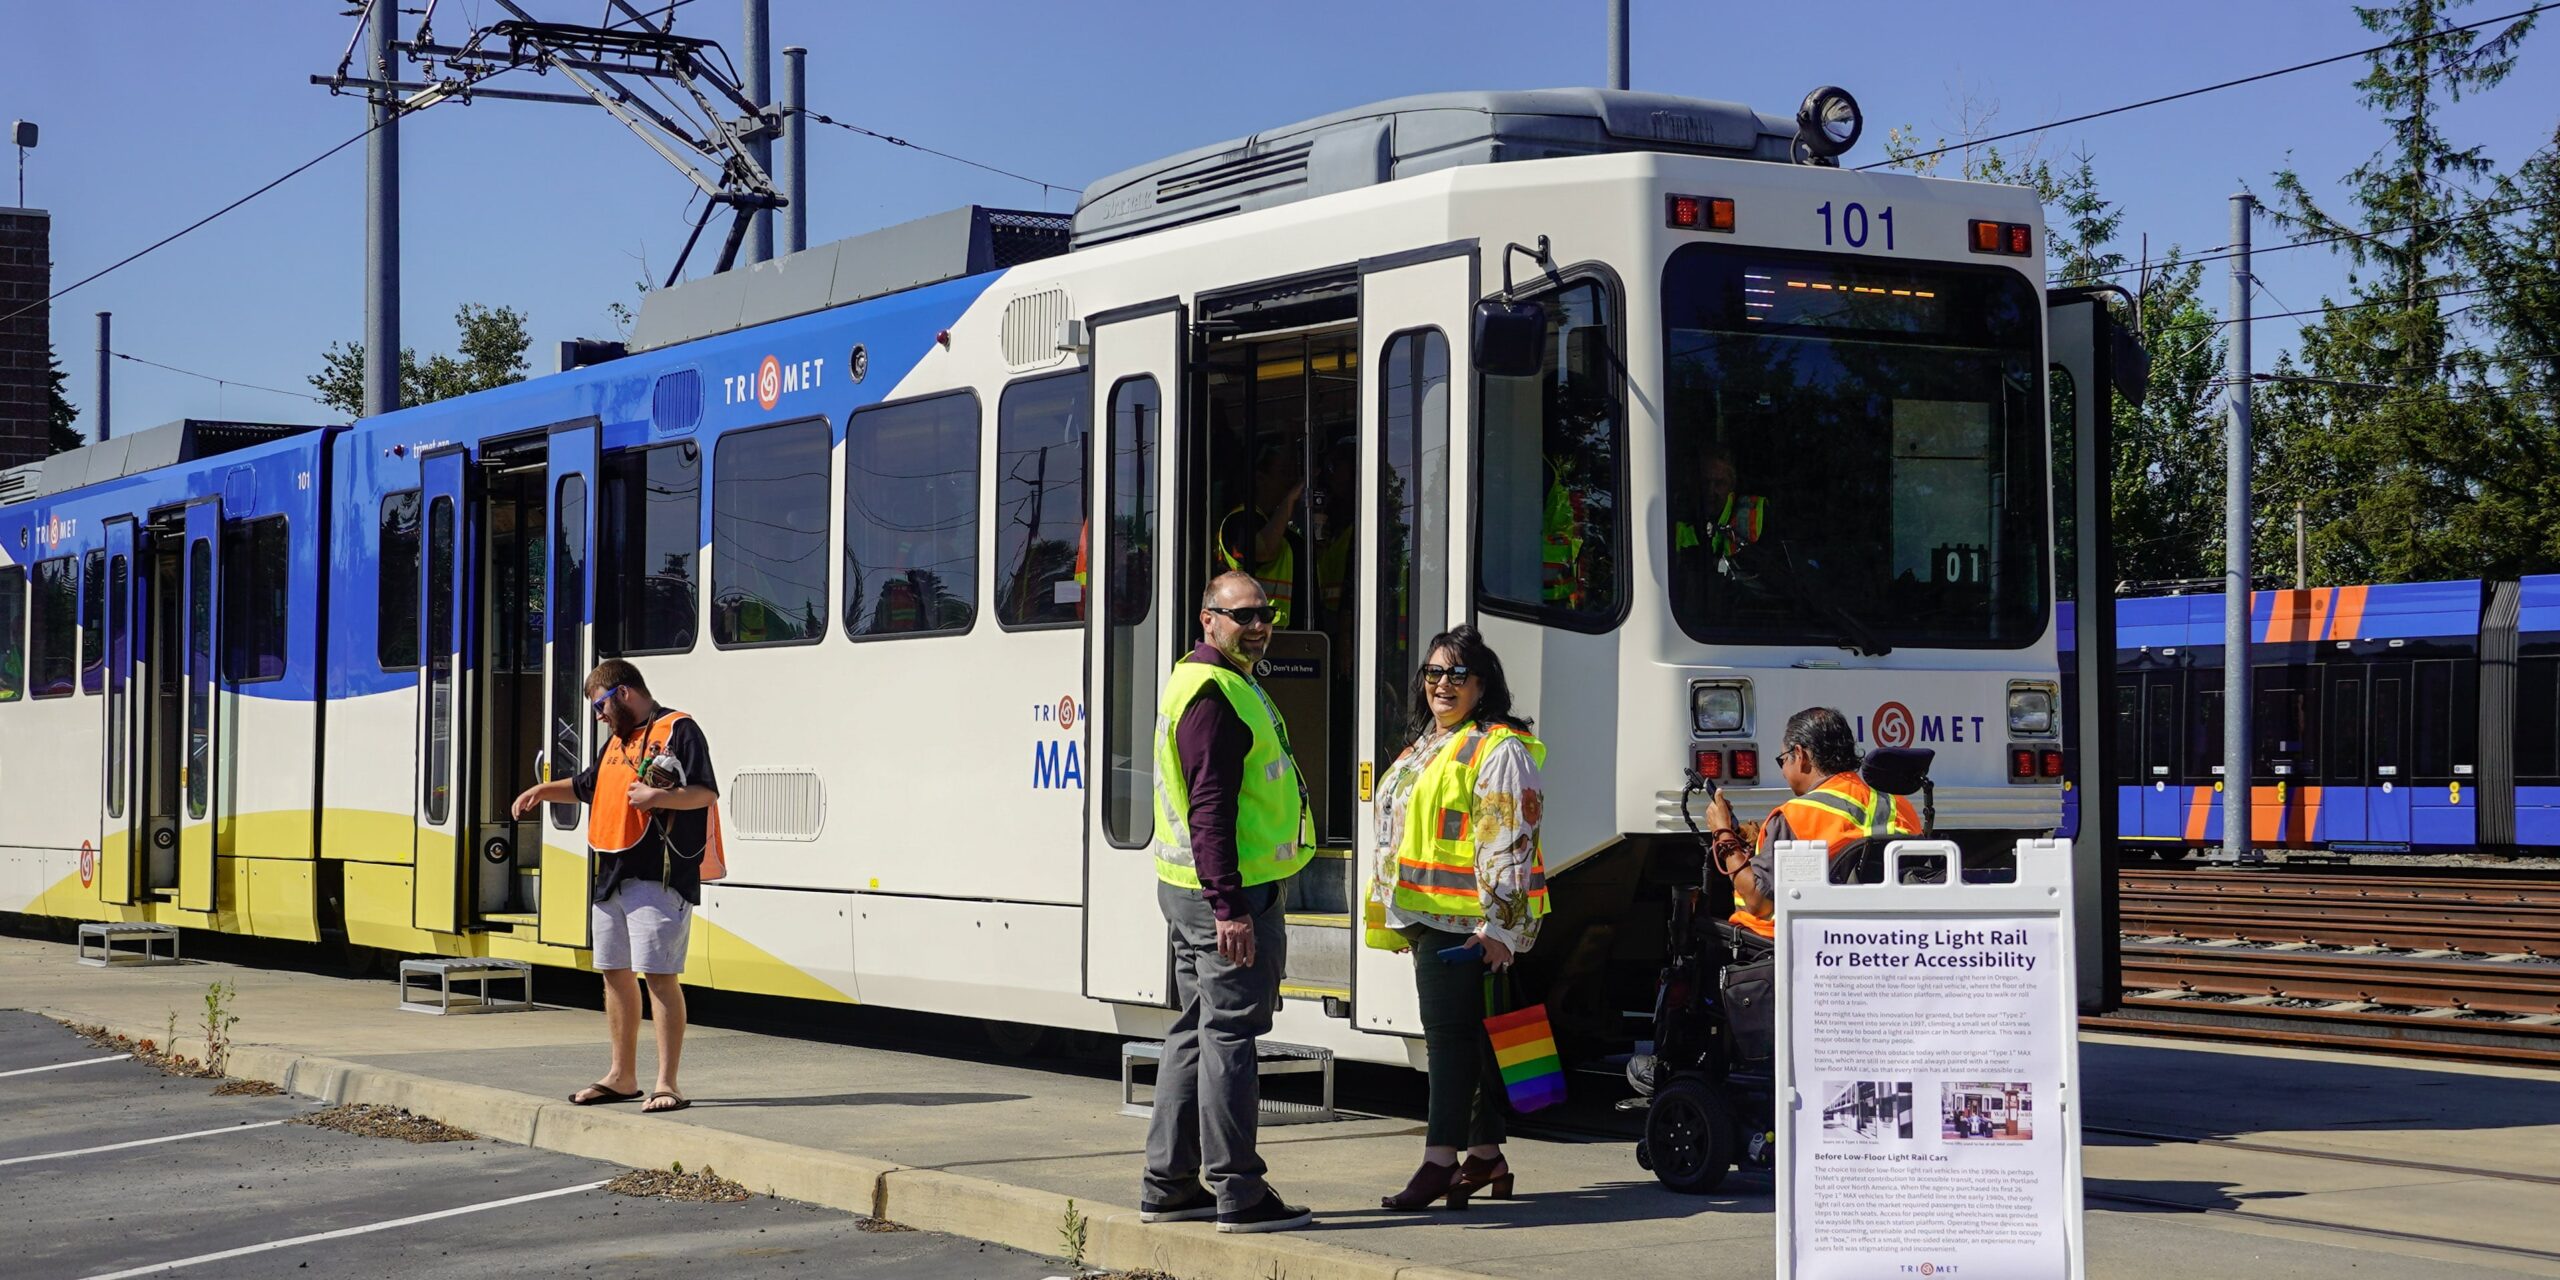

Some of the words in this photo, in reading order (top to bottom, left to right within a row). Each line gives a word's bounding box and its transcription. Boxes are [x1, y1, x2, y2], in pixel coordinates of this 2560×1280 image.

[1816, 201, 1894, 250] 101
[297, 471, 310, 490] 101
[1272, 664, 1290, 672] Don't
[1291, 664, 1299, 672] sit
[1300, 664, 1314, 673] here
[1033, 740, 1085, 789] MA
[1824, 930, 1929, 949] Innovating
[1935, 930, 1984, 949] Light
[1991, 930, 2027, 945] Rail
[1816, 951, 1843, 966] for
[1849, 953, 1909, 967] Better
[1915, 952, 2035, 971] Accessibility
[1833, 982, 1855, 990] talking
[1917, 982, 1932, 990] light
[1888, 1153, 1910, 1162] Light
[1825, 1218, 1851, 1226] wayside
[1916, 1219, 1946, 1227] platform.
[1859, 1245, 1899, 1253] stigmatizing
